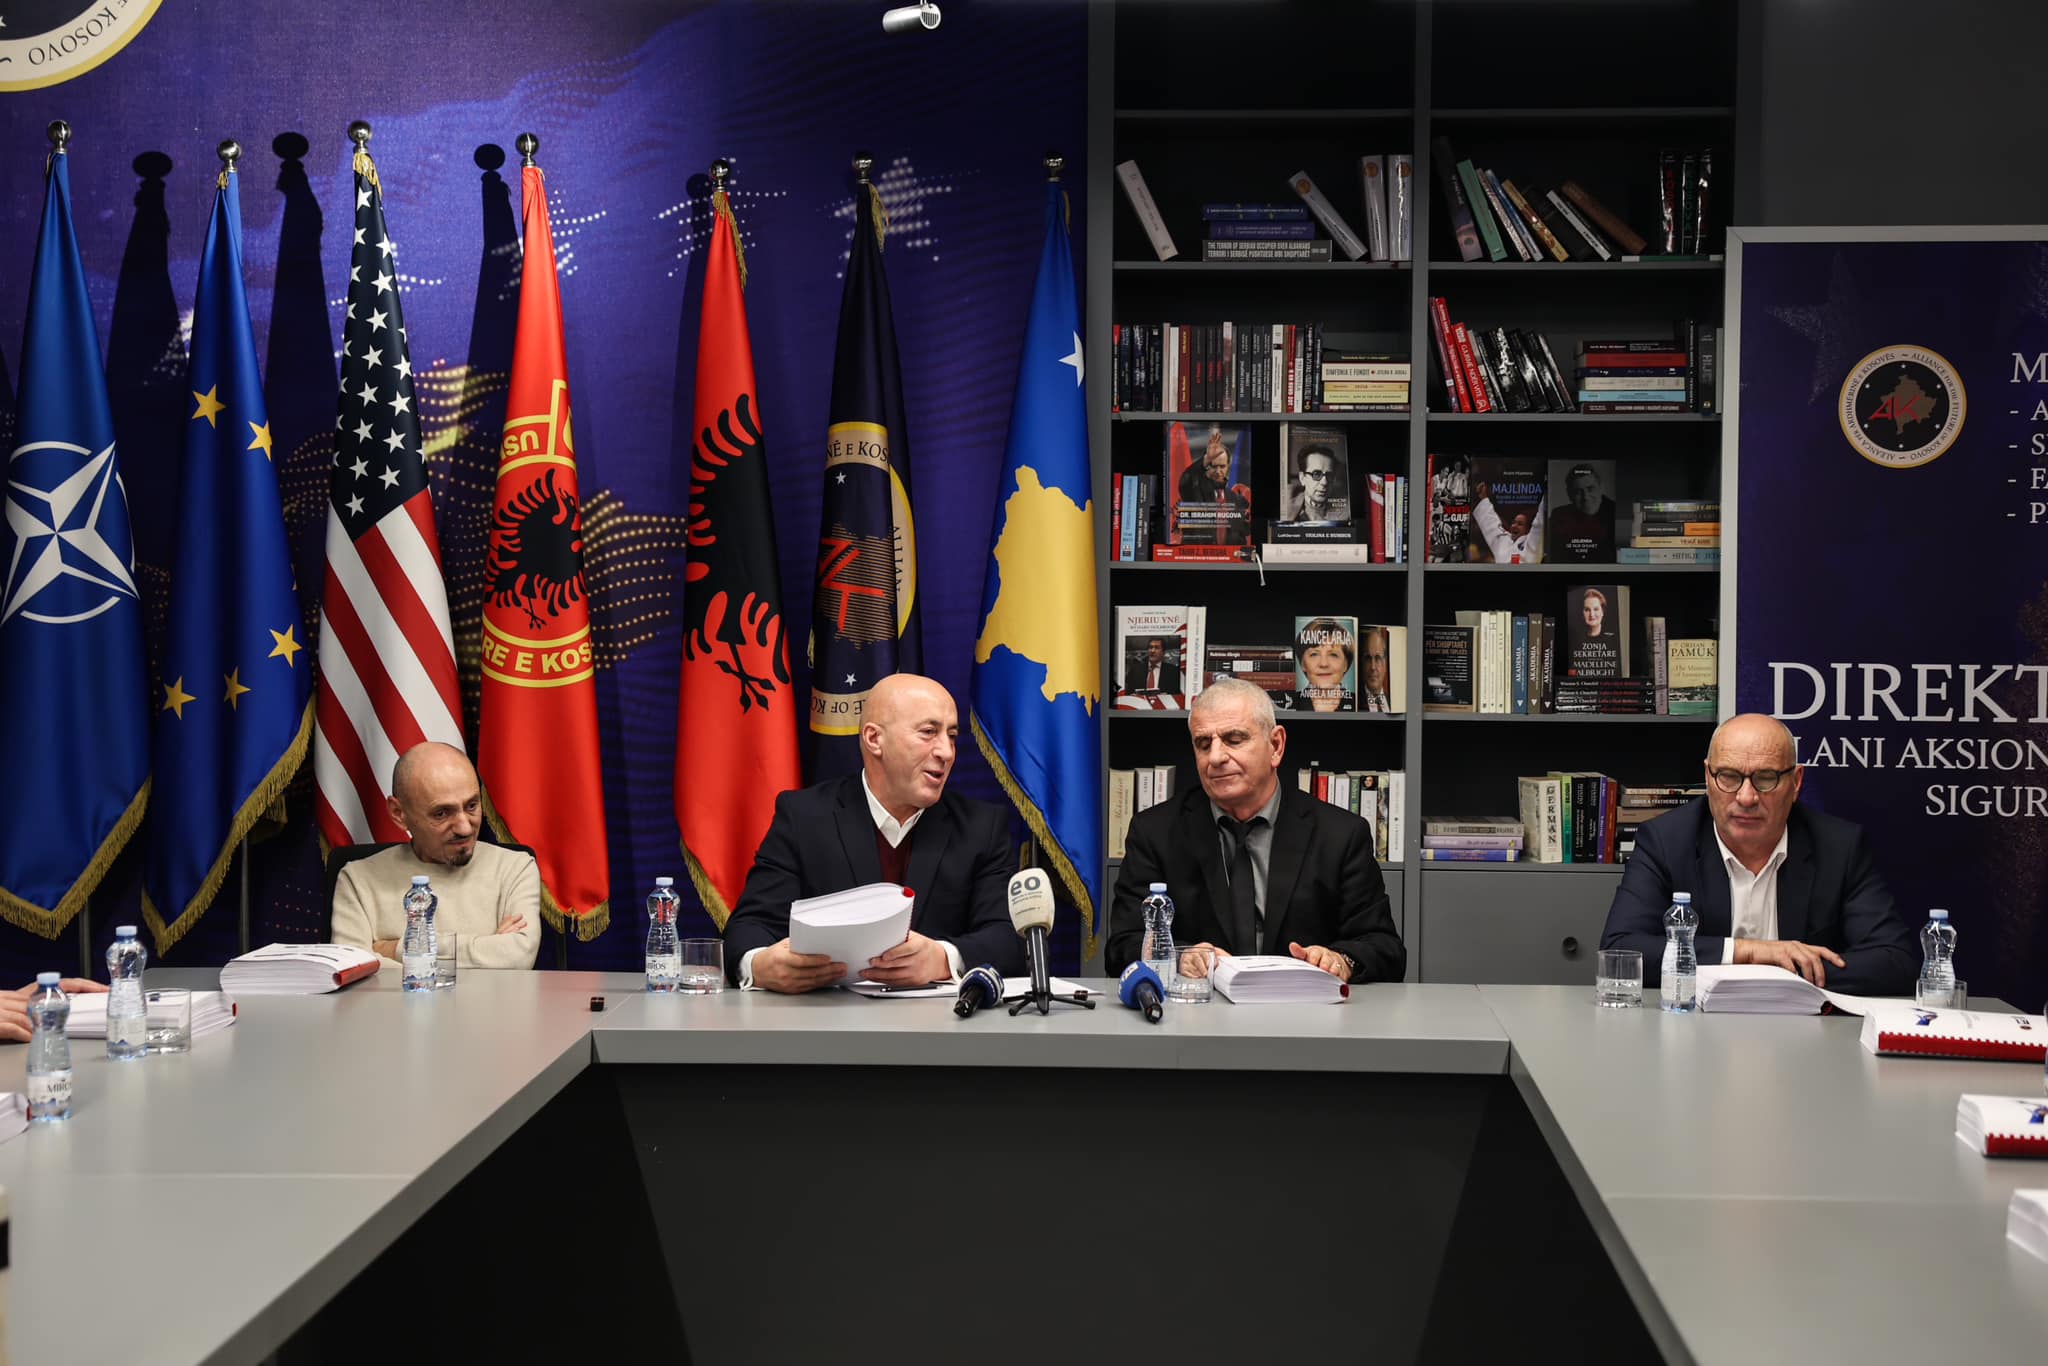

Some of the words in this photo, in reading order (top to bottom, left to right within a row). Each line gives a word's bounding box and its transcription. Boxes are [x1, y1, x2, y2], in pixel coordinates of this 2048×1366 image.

[28, 6, 118, 65] KOSOVO
[1911, 353, 1945, 376] ALLIANCE
[1946, 400, 1959, 432] FUTURE
[846, 443, 853, 456] E
[858, 441, 889, 463] KOS
[1862, 439, 1896, 461] ALEANCA
[1910, 439, 1942, 461] KOSOVO
[2030, 432, 2048, 456] S
[1492, 482, 1542, 494] MAJLINDA
[2029, 468, 2048, 489] F
[2029, 502, 2048, 524] P
[892, 524, 903, 593] ALLIAN
[1128, 616, 1159, 624] NJERIU
[1161, 615, 1180, 624] YNË
[1300, 630, 1352, 644] KANCELARJA
[1582, 642, 1607, 650] ZONJA
[481, 635, 509, 668] RE
[515, 651, 533, 673] E
[542, 641, 592, 675] KOS
[1573, 650, 1616, 658] SEKRETARE
[1672, 648, 1714, 656] PAMUK
[1573, 660, 1616, 668] MADELEINE
[1300, 690, 1326, 698] ANGELA
[1328, 690, 1352, 699] MERKEL
[1768, 661, 2048, 723] DIREKT
[830, 701, 849, 714] OF
[1795, 737, 1886, 769] LANI
[1896, 738, 2048, 771] AKSION
[1546, 786, 1557, 843] GERMAN
[1010, 876, 1040, 896] eo
